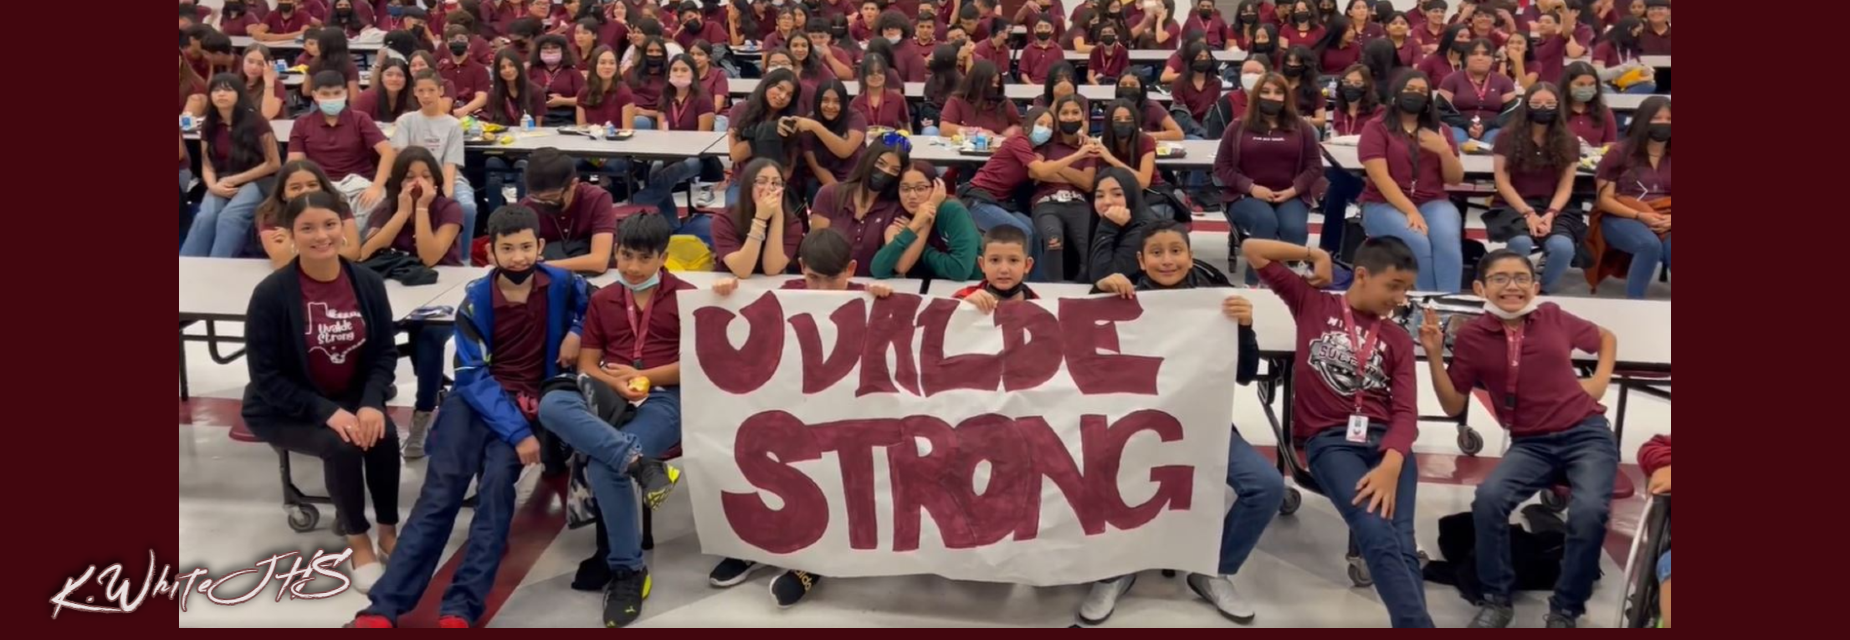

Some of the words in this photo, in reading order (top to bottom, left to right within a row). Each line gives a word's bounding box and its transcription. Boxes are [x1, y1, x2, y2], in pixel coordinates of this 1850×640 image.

[317, 319, 353, 334] Uvalde
[317, 332, 355, 345] Strong
[1326, 316, 1387, 352] MISIN
[694, 289, 1164, 398] UVALDE
[1319, 345, 1378, 375] SOCCR
[721, 409, 1195, 554] STRONG
